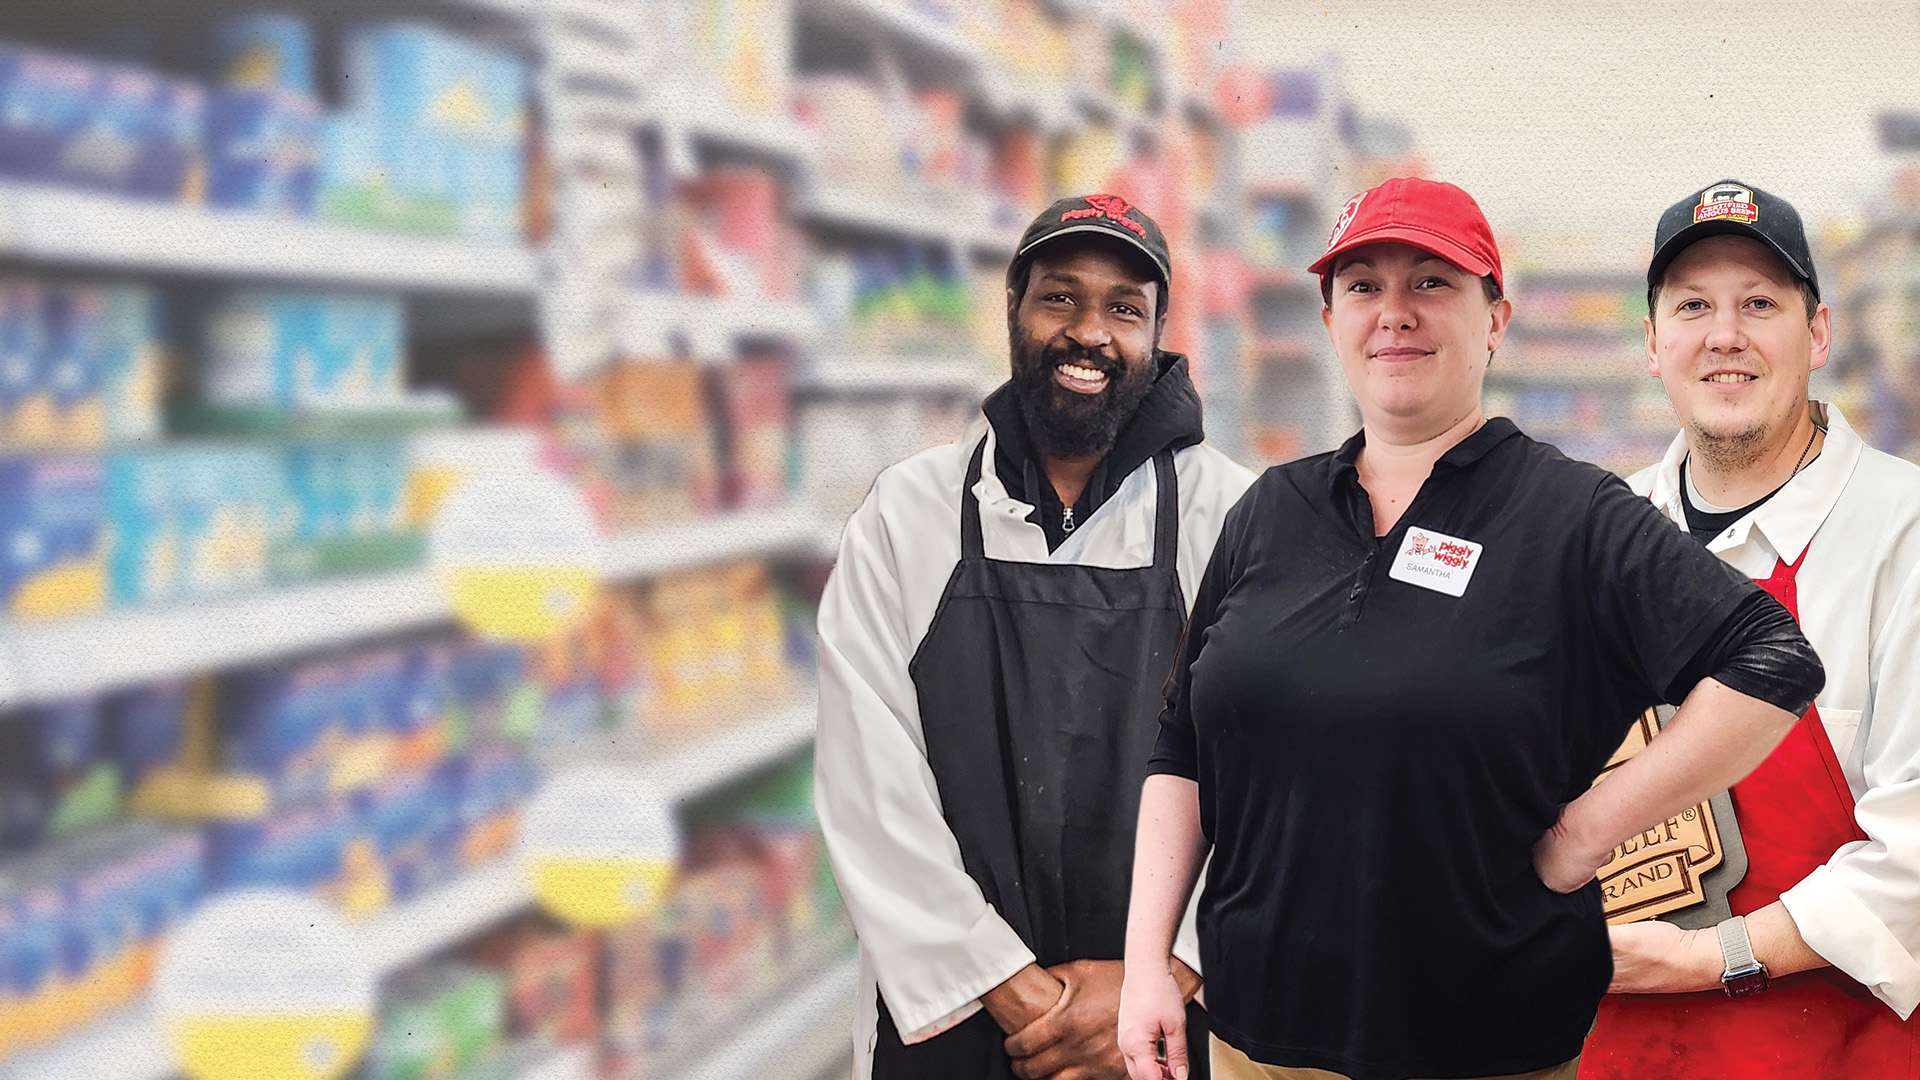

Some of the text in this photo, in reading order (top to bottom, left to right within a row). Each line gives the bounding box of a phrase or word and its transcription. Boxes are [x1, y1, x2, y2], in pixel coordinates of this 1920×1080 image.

[1697, 208, 1729, 220] ANGUS
[1701, 202, 1748, 213] CERTIFIED
[1438, 541, 1474, 558] piggly
[1433, 551, 1470, 570] wiggly
[1406, 562, 1451, 579] SAMANTHA
[1609, 807, 1697, 863] EEF®
[1601, 862, 1674, 904] RAND
